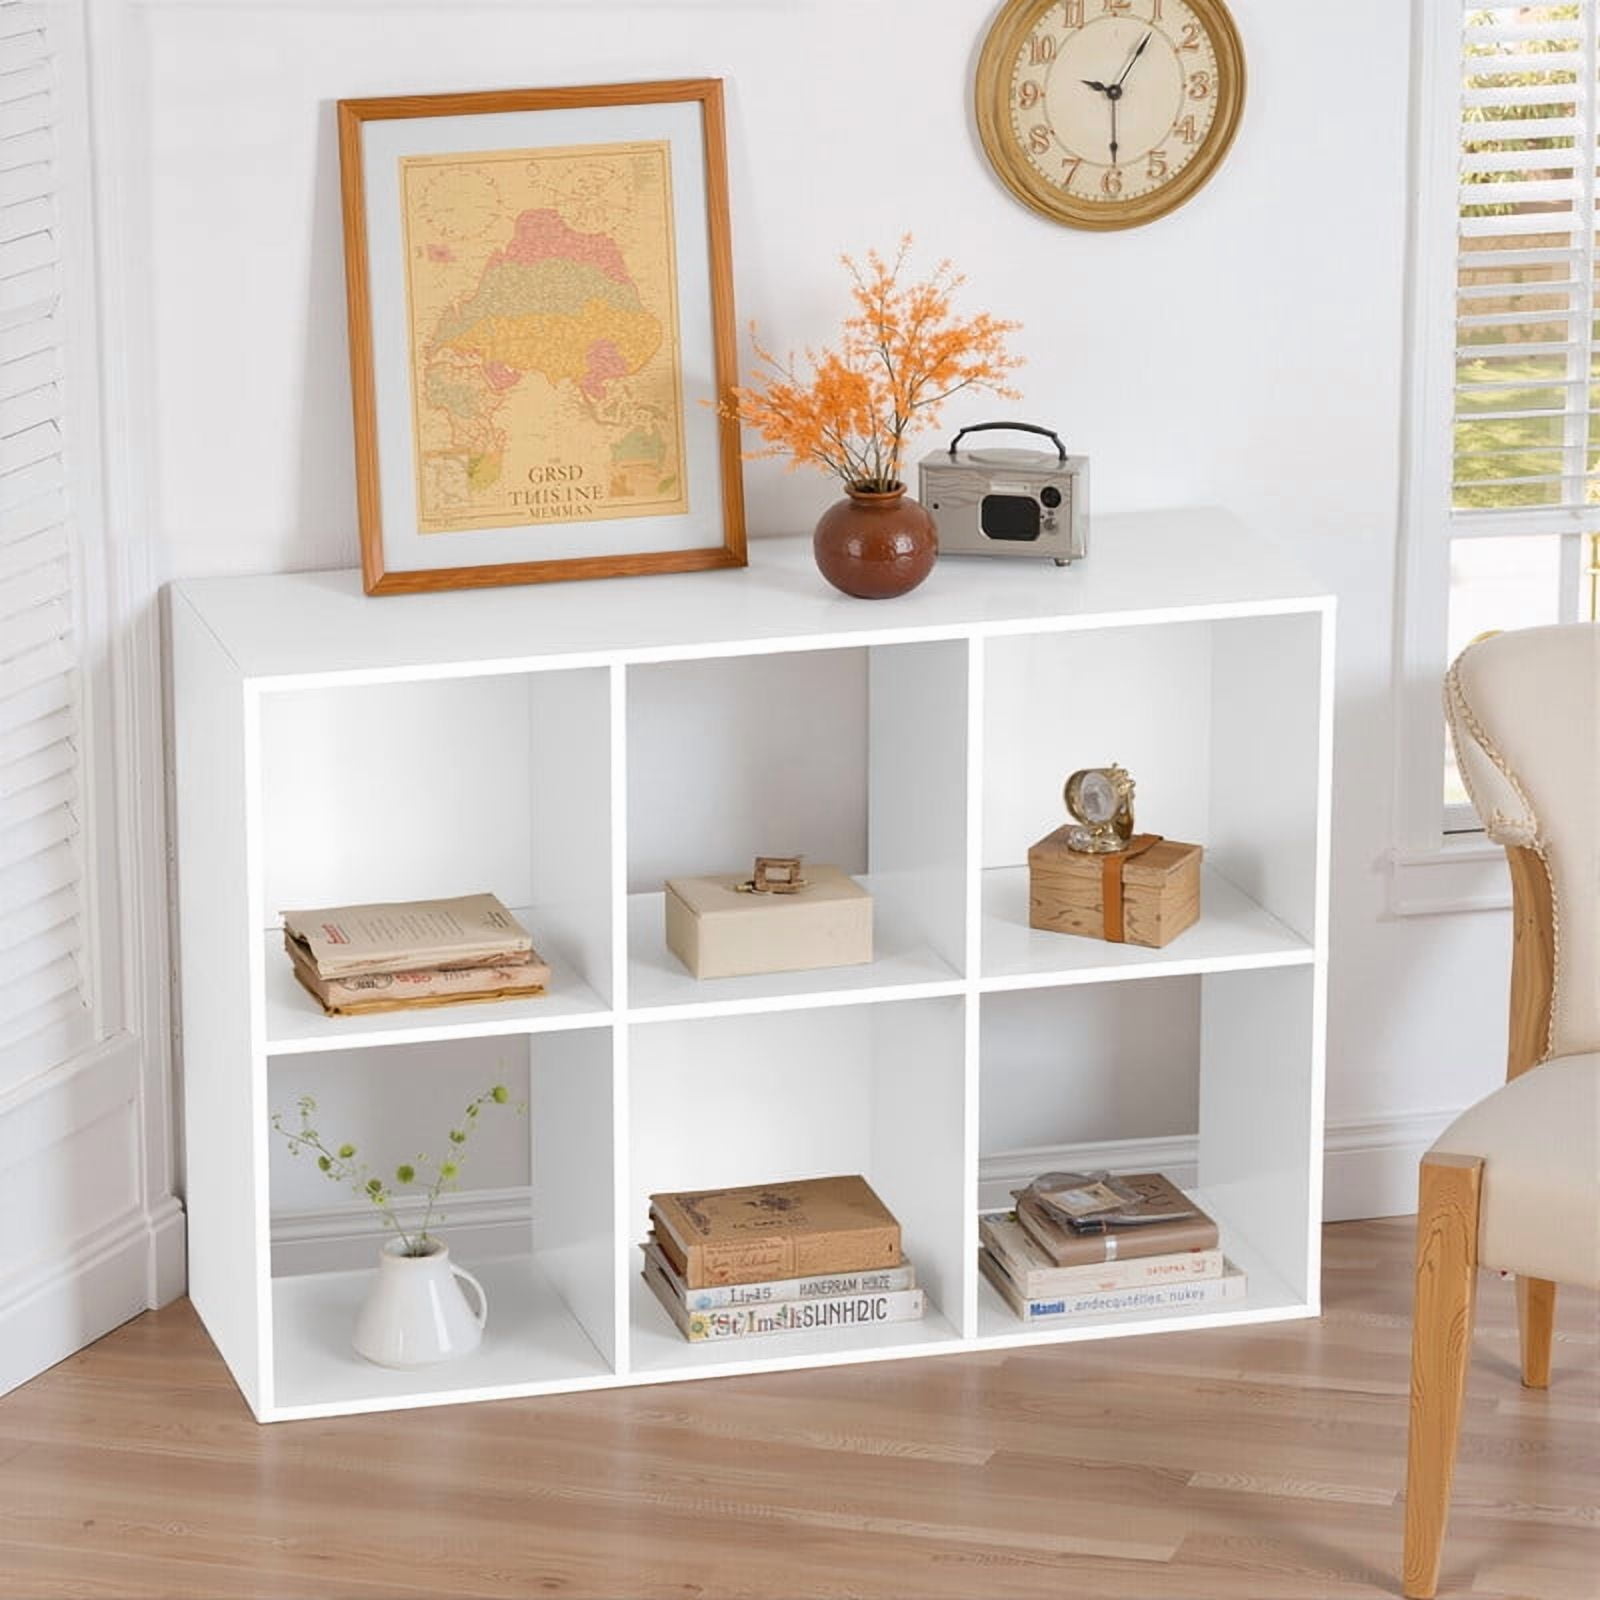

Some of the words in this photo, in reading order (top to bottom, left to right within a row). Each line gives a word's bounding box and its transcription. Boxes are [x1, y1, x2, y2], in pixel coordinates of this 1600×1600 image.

[1030, 36, 1057, 66] 10
[1181, 24, 1200, 50] 2
[1018, 80, 1038, 110] 9
[1189, 71, 1210, 100] 3
[1028, 125, 1051, 154] 8
[1174, 115, 1197, 144] 4
[1061, 158, 1083, 188] 7
[1146, 151, 1168, 178] 5
[1100, 168, 1123, 194] 6
